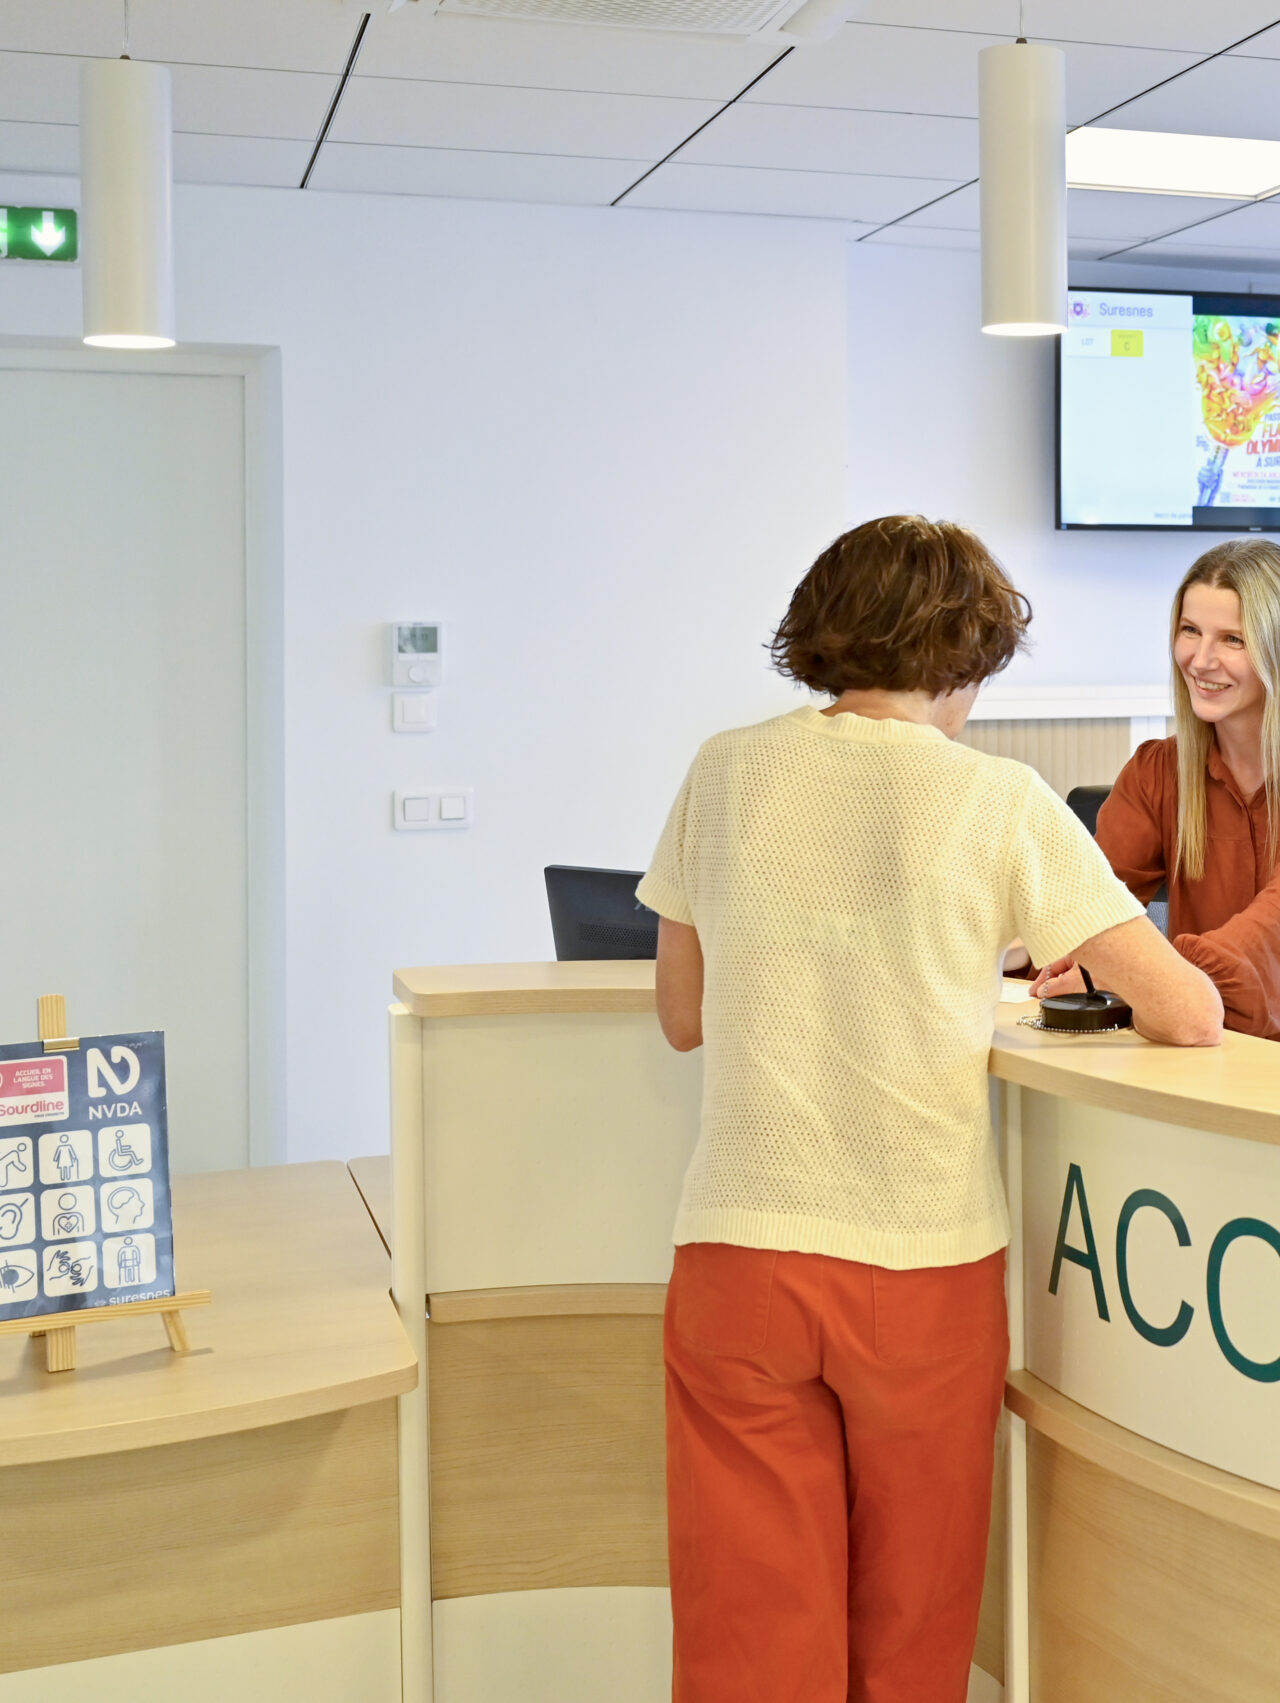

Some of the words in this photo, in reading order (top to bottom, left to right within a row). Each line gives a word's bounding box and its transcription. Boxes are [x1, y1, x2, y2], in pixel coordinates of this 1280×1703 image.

[1099, 302, 1153, 318] Suresnes
[13, 1074, 40, 1083] LANGUE
[40, 1073, 54, 1081] DES
[15, 1068, 40, 1077] ACCUEIL
[0, 1099, 65, 1117] Sourdline
[88, 1101, 142, 1120] NVDA
[108, 1289, 170, 1305] suresnes
